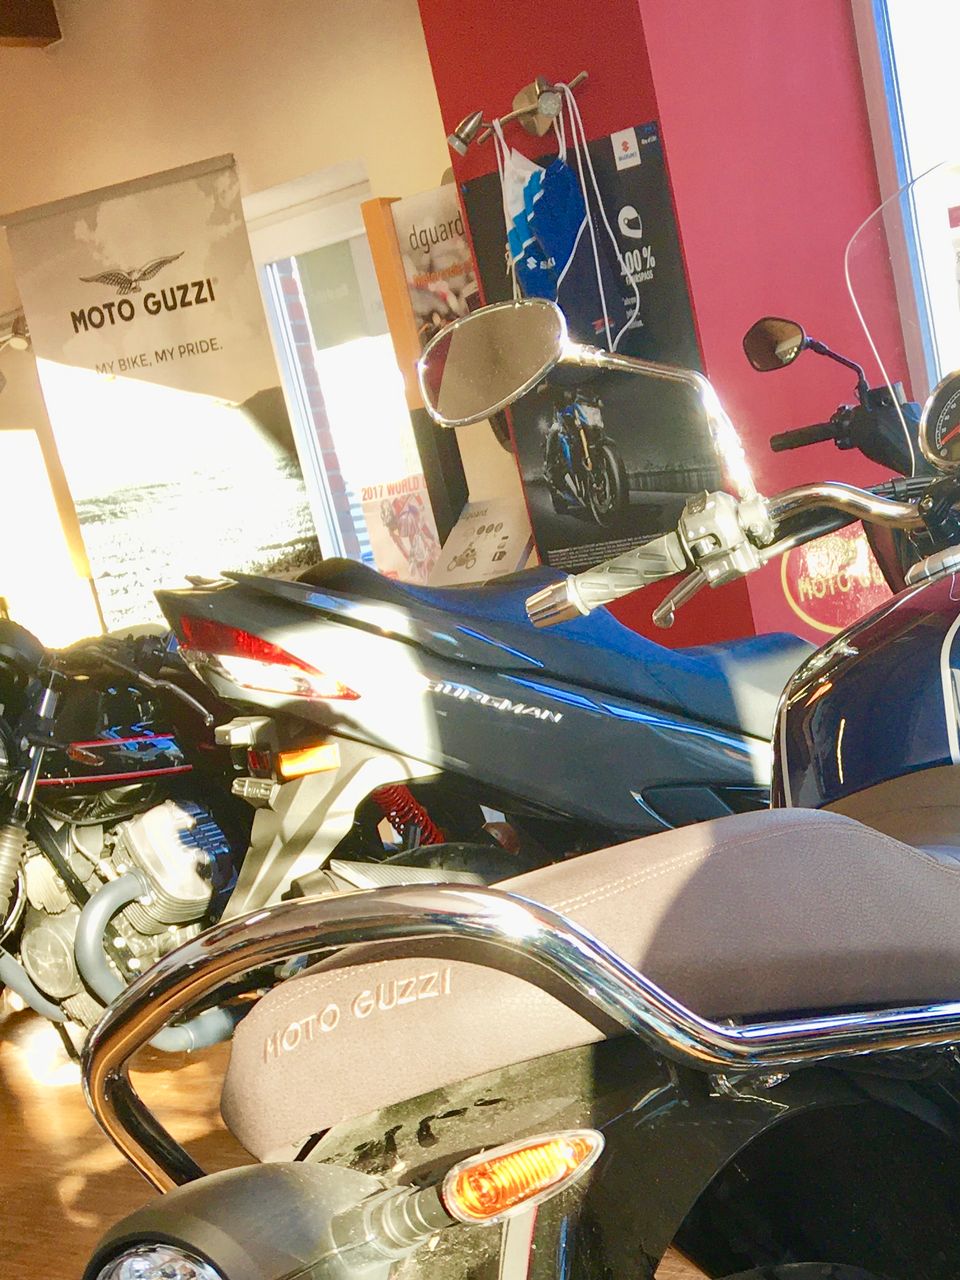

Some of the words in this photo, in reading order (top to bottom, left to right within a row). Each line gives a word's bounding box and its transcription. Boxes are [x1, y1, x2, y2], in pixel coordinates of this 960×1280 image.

[409, 211, 464, 254] dguard
[70, 298, 135, 333] MOTO
[143, 278, 216, 315] GUZZI
[95, 361, 115, 375] MY
[118, 353, 152, 372] BIKE,
[154, 346, 175, 363] MY
[178, 337, 223, 359] PRIDE.
[362, 485, 384, 501] 2017
[387, 478, 420, 496] WORLD
[798, 571, 851, 602] MOTO
[264, 1003, 341, 1063] MOTO
[351, 967, 452, 1019] GUZZI
